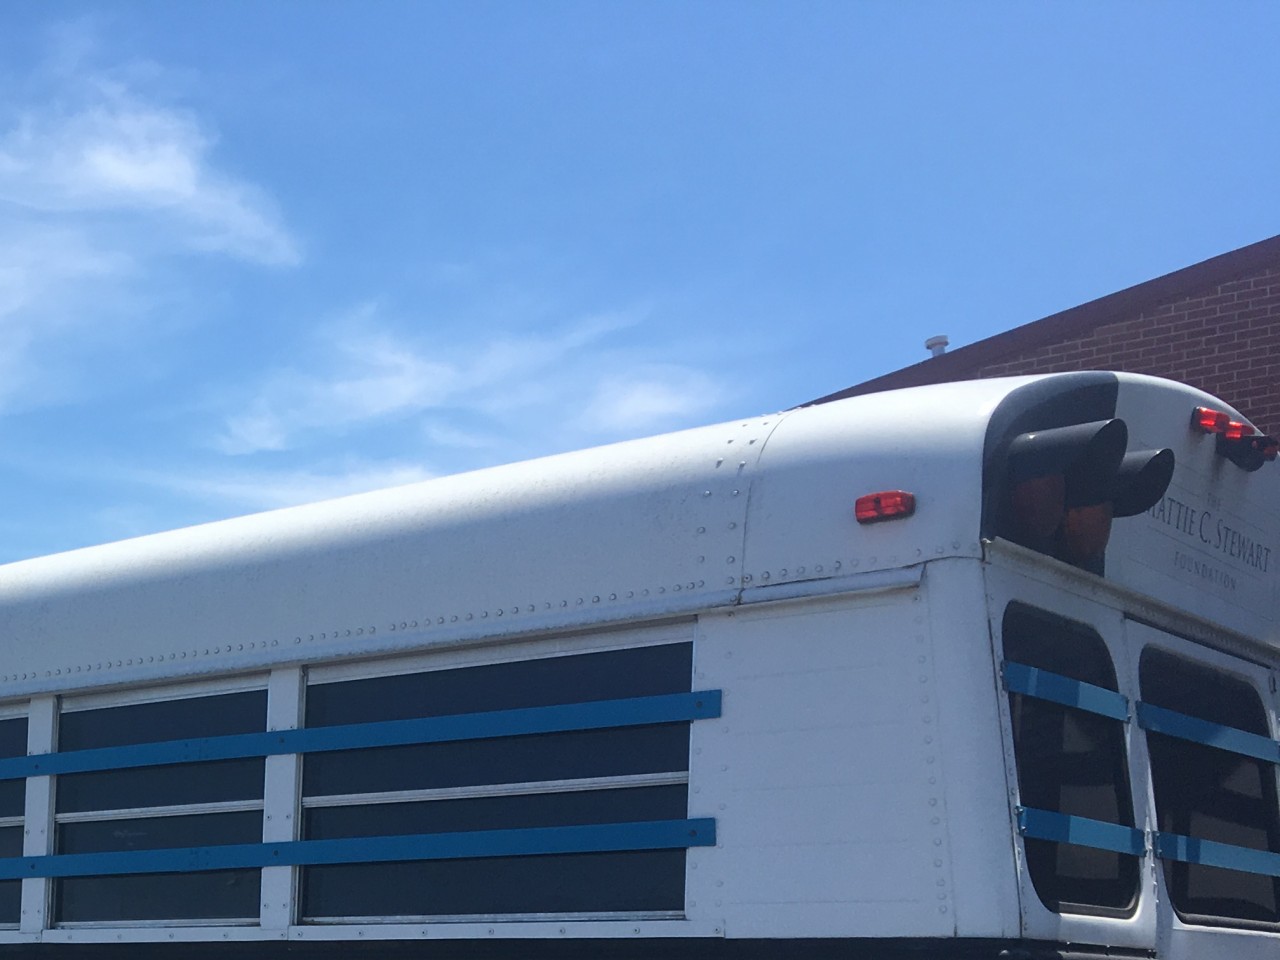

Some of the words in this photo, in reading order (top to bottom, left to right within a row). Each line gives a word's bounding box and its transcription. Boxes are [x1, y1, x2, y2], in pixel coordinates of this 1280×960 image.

[1199, 511, 1211, 544] C.
[1215, 519, 1271, 573] STEWART
[1174, 551, 1235, 590] FOUNDATION
